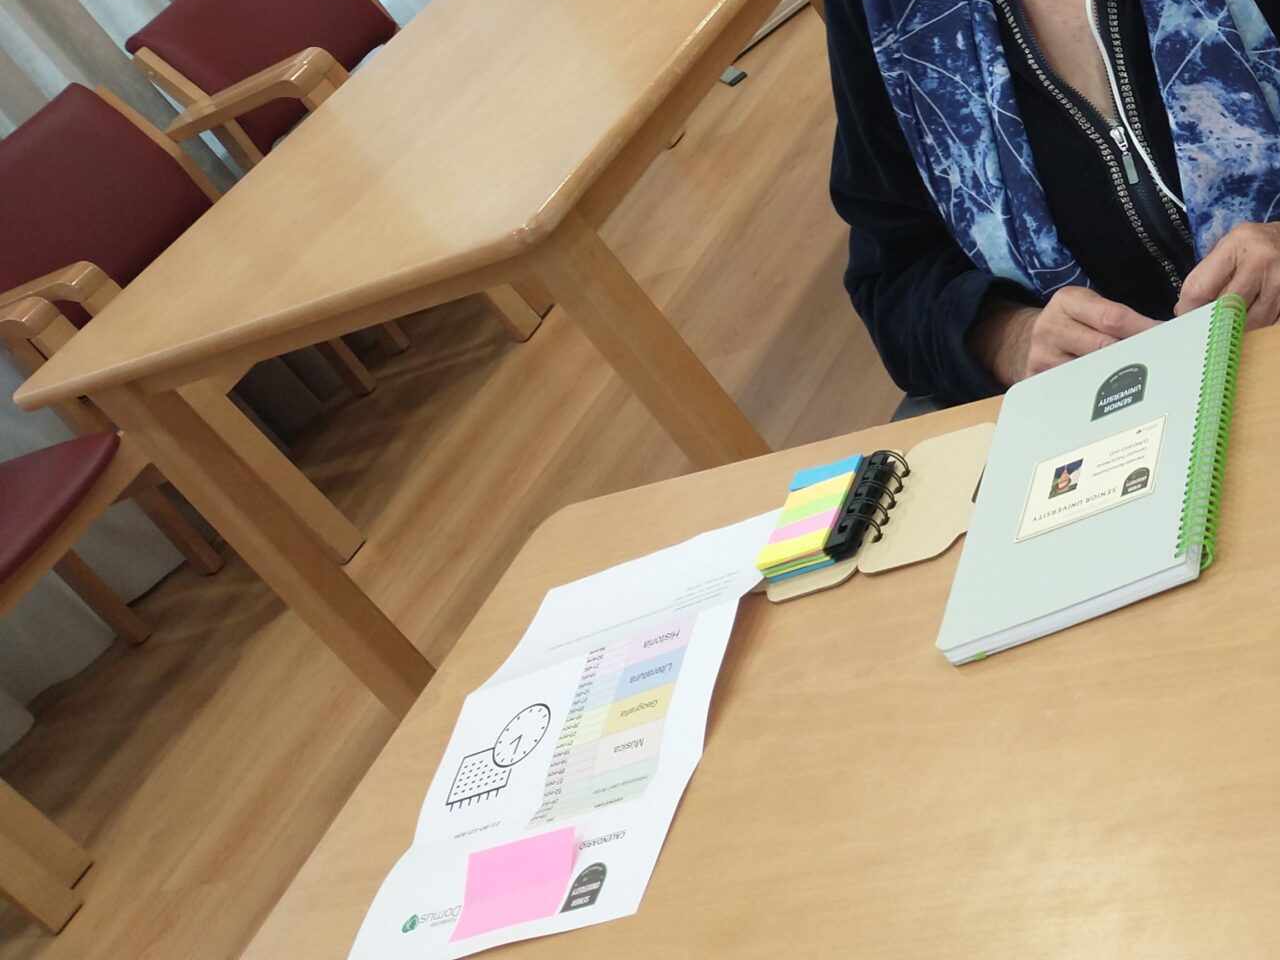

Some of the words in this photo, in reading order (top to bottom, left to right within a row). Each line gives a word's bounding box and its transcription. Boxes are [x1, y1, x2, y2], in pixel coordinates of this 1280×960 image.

[1098, 384, 1141, 407] UNIVERSITY
[1103, 396, 1133, 413] SENIOR
[1085, 487, 1117, 503] SENIOR
[1032, 500, 1082, 522] UNIVERSITY
[643, 630, 680, 648] Historia
[629, 662, 672, 683] Literatura
[613, 737, 644, 753] Música
[579, 831, 626, 849] CALENDARIO
